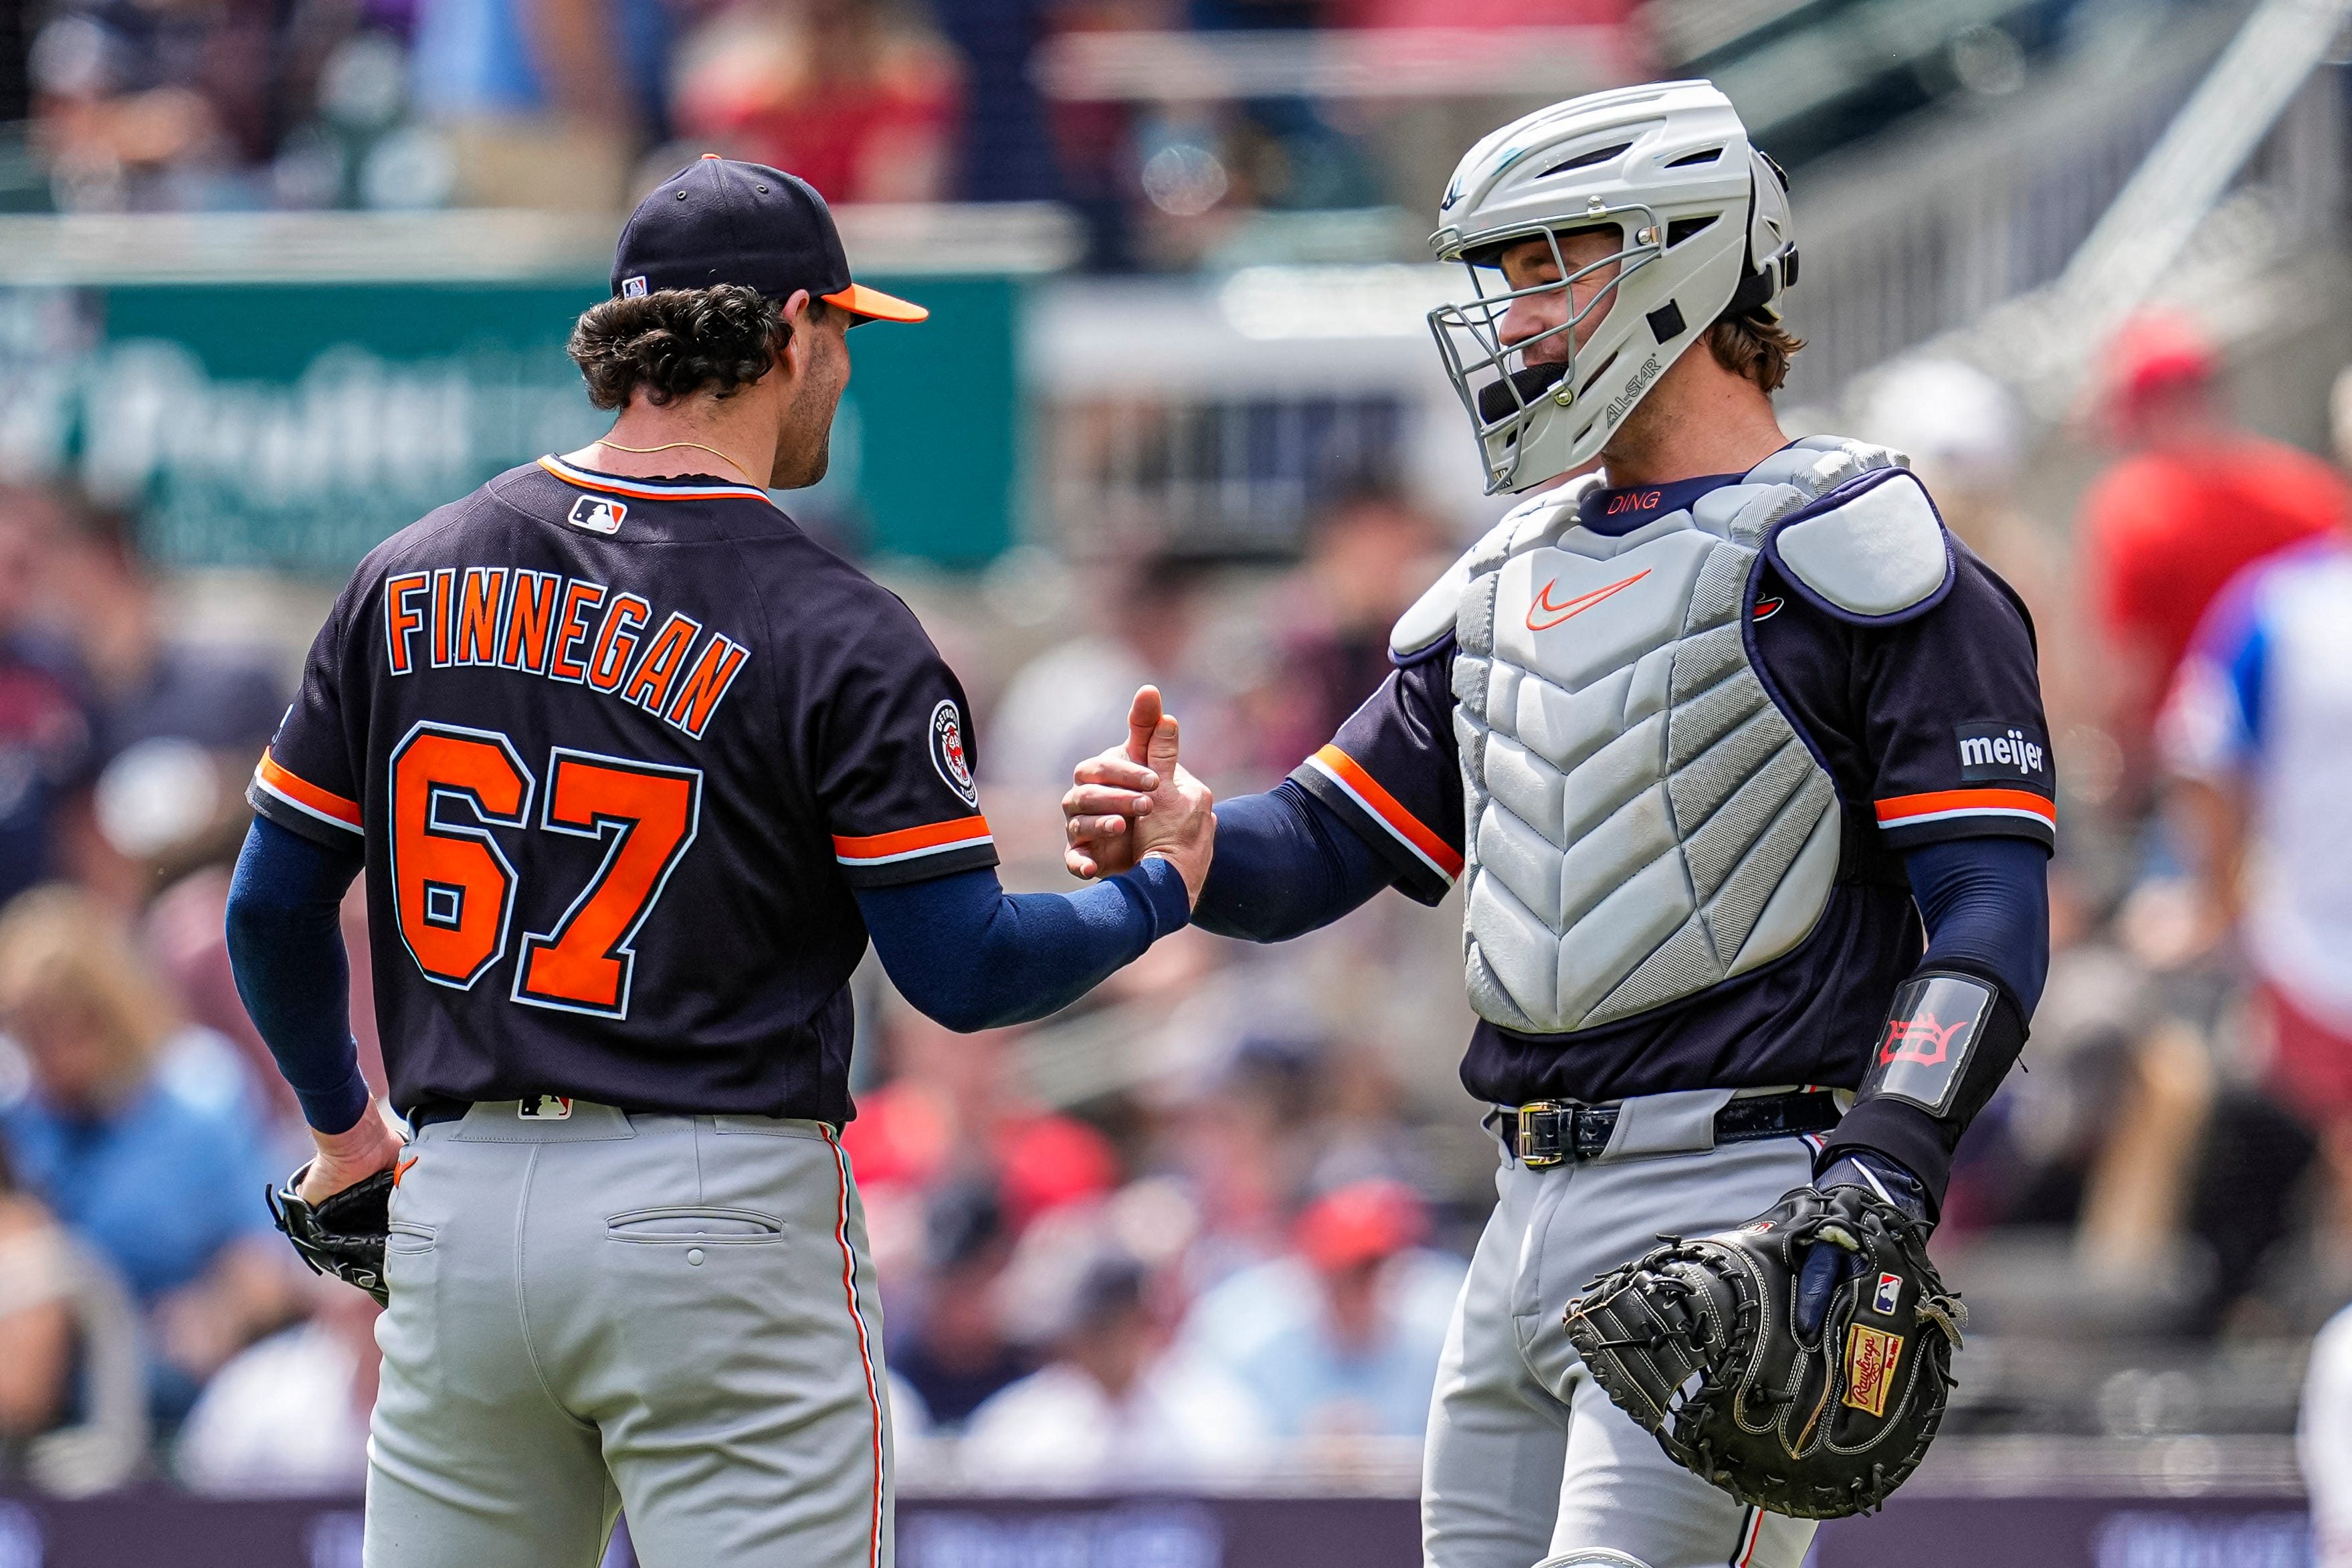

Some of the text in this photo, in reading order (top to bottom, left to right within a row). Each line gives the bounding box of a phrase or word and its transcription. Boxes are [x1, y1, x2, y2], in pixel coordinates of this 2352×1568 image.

[1606, 357, 1662, 429] ALL-STAR
[1607, 490, 1662, 514] DING
[385, 567, 751, 741] FINNEGAN
[1959, 729, 2043, 775] meijer
[389, 719, 704, 1020] 67
[1852, 1336, 1882, 1405] Rawlings
